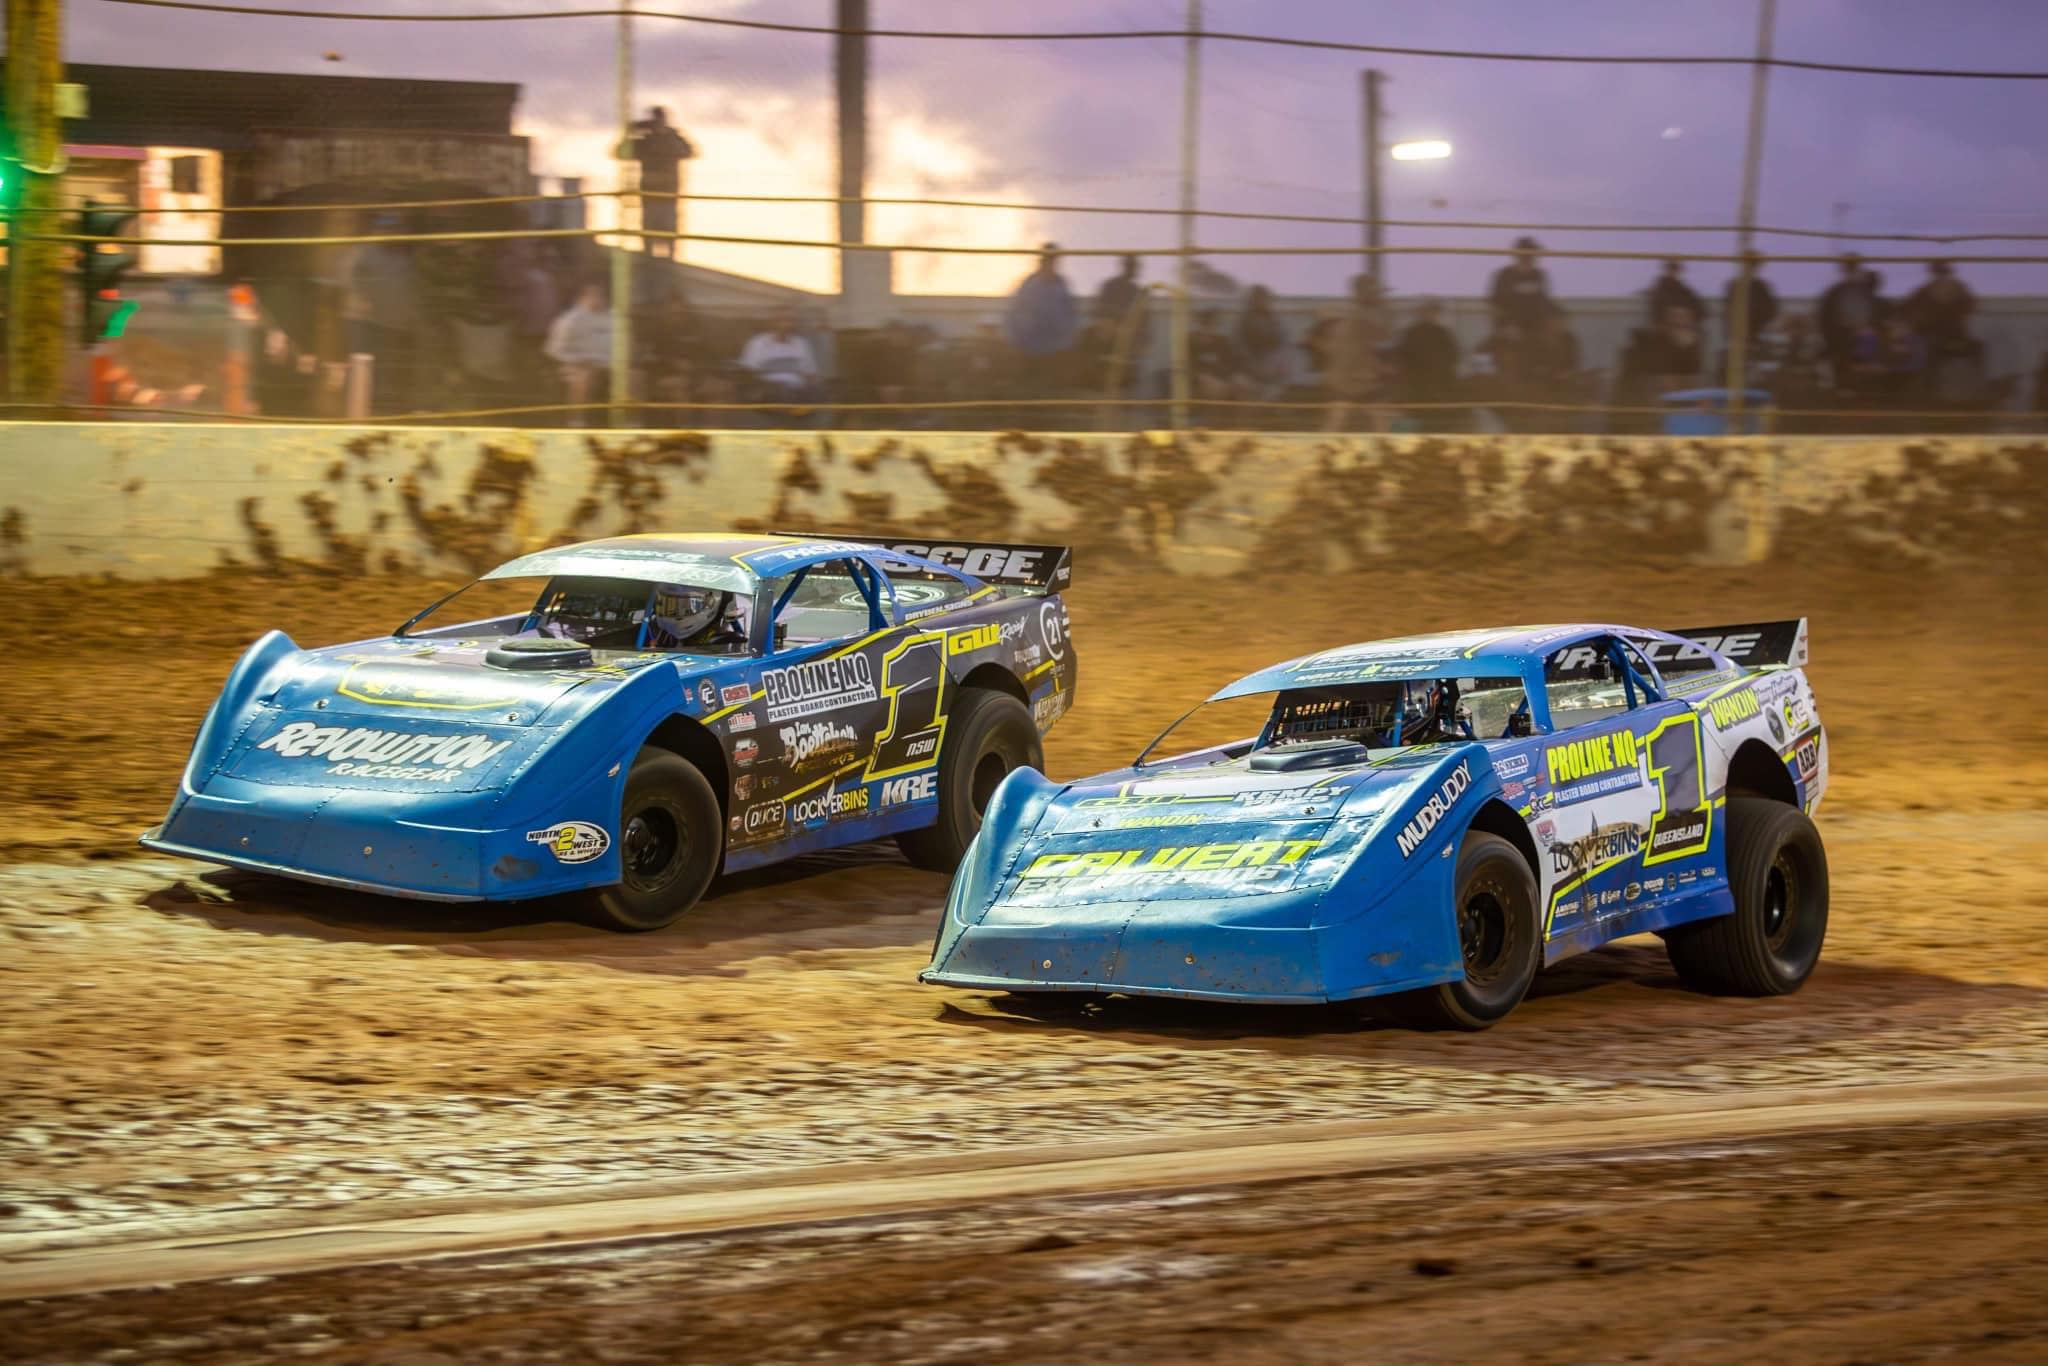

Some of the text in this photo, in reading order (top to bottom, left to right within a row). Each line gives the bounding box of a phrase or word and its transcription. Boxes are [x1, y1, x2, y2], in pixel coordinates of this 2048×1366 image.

[762, 660, 840, 706] PROLINE
[769, 706, 799, 720] PLASTER
[825, 690, 875, 708] CONTRACTORS
[1709, 687, 1761, 732] WANDIN
[257, 722, 513, 768] REVOLUTION
[1546, 735, 1614, 785] PROLINE
[1612, 729, 1638, 768] NQ
[325, 763, 463, 783] RACEGEAR
[880, 771, 938, 806] KRE
[1555, 787, 1579, 803] PLASTER
[1600, 772, 1640, 791] CONTRACTORS
[1642, 711, 1713, 867] 1
[1396, 758, 1472, 858] MUDBUDDY
[528, 827, 598, 851] NORTH 2 WEST
[1653, 824, 1703, 849] QUEENSLAND
[1017, 839, 1324, 878] CALVERT
